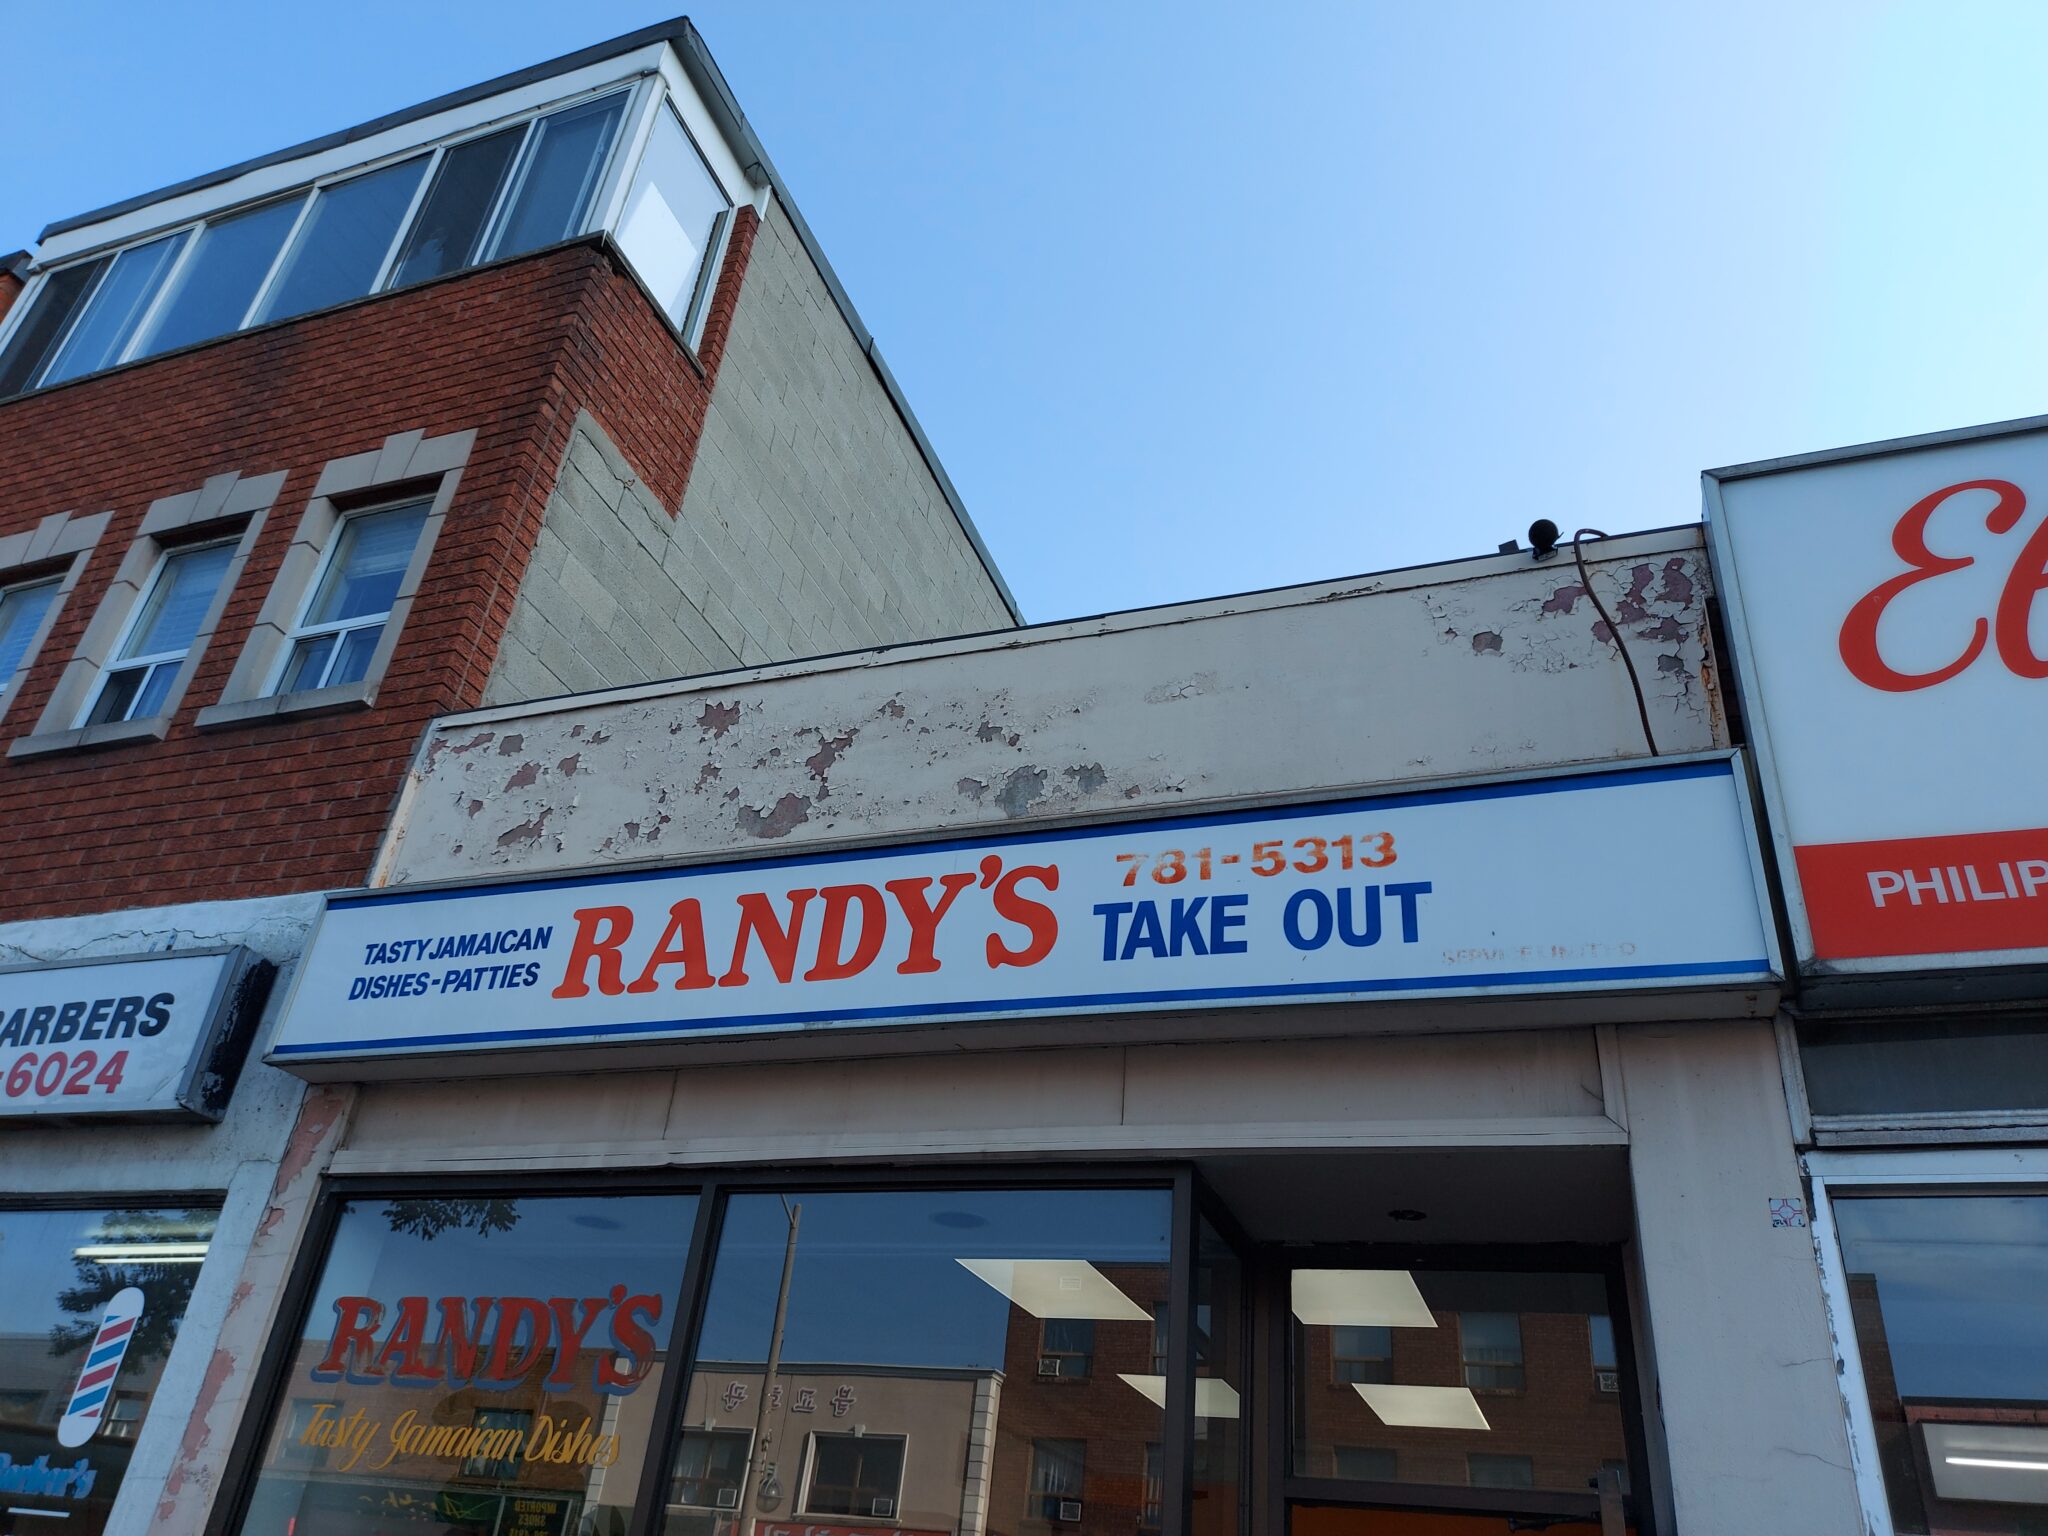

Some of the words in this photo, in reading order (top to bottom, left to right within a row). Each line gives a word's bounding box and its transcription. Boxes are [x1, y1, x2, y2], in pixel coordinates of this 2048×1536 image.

[1115, 831, 1398, 887] 781-5313
[364, 938, 433, 966] TASTY
[428, 926, 554, 960] JAMAICAN
[551, 854, 1060, 999] RANDY'S
[1093, 894, 1249, 962] TAKE
[1283, 881, 1433, 951] OUT
[310, 1283, 663, 1396] RANDY'S
[301, 1404, 381, 1472] Tasty
[369, 1409, 524, 1471] Jamaican
[524, 1415, 622, 1467] Dishes
